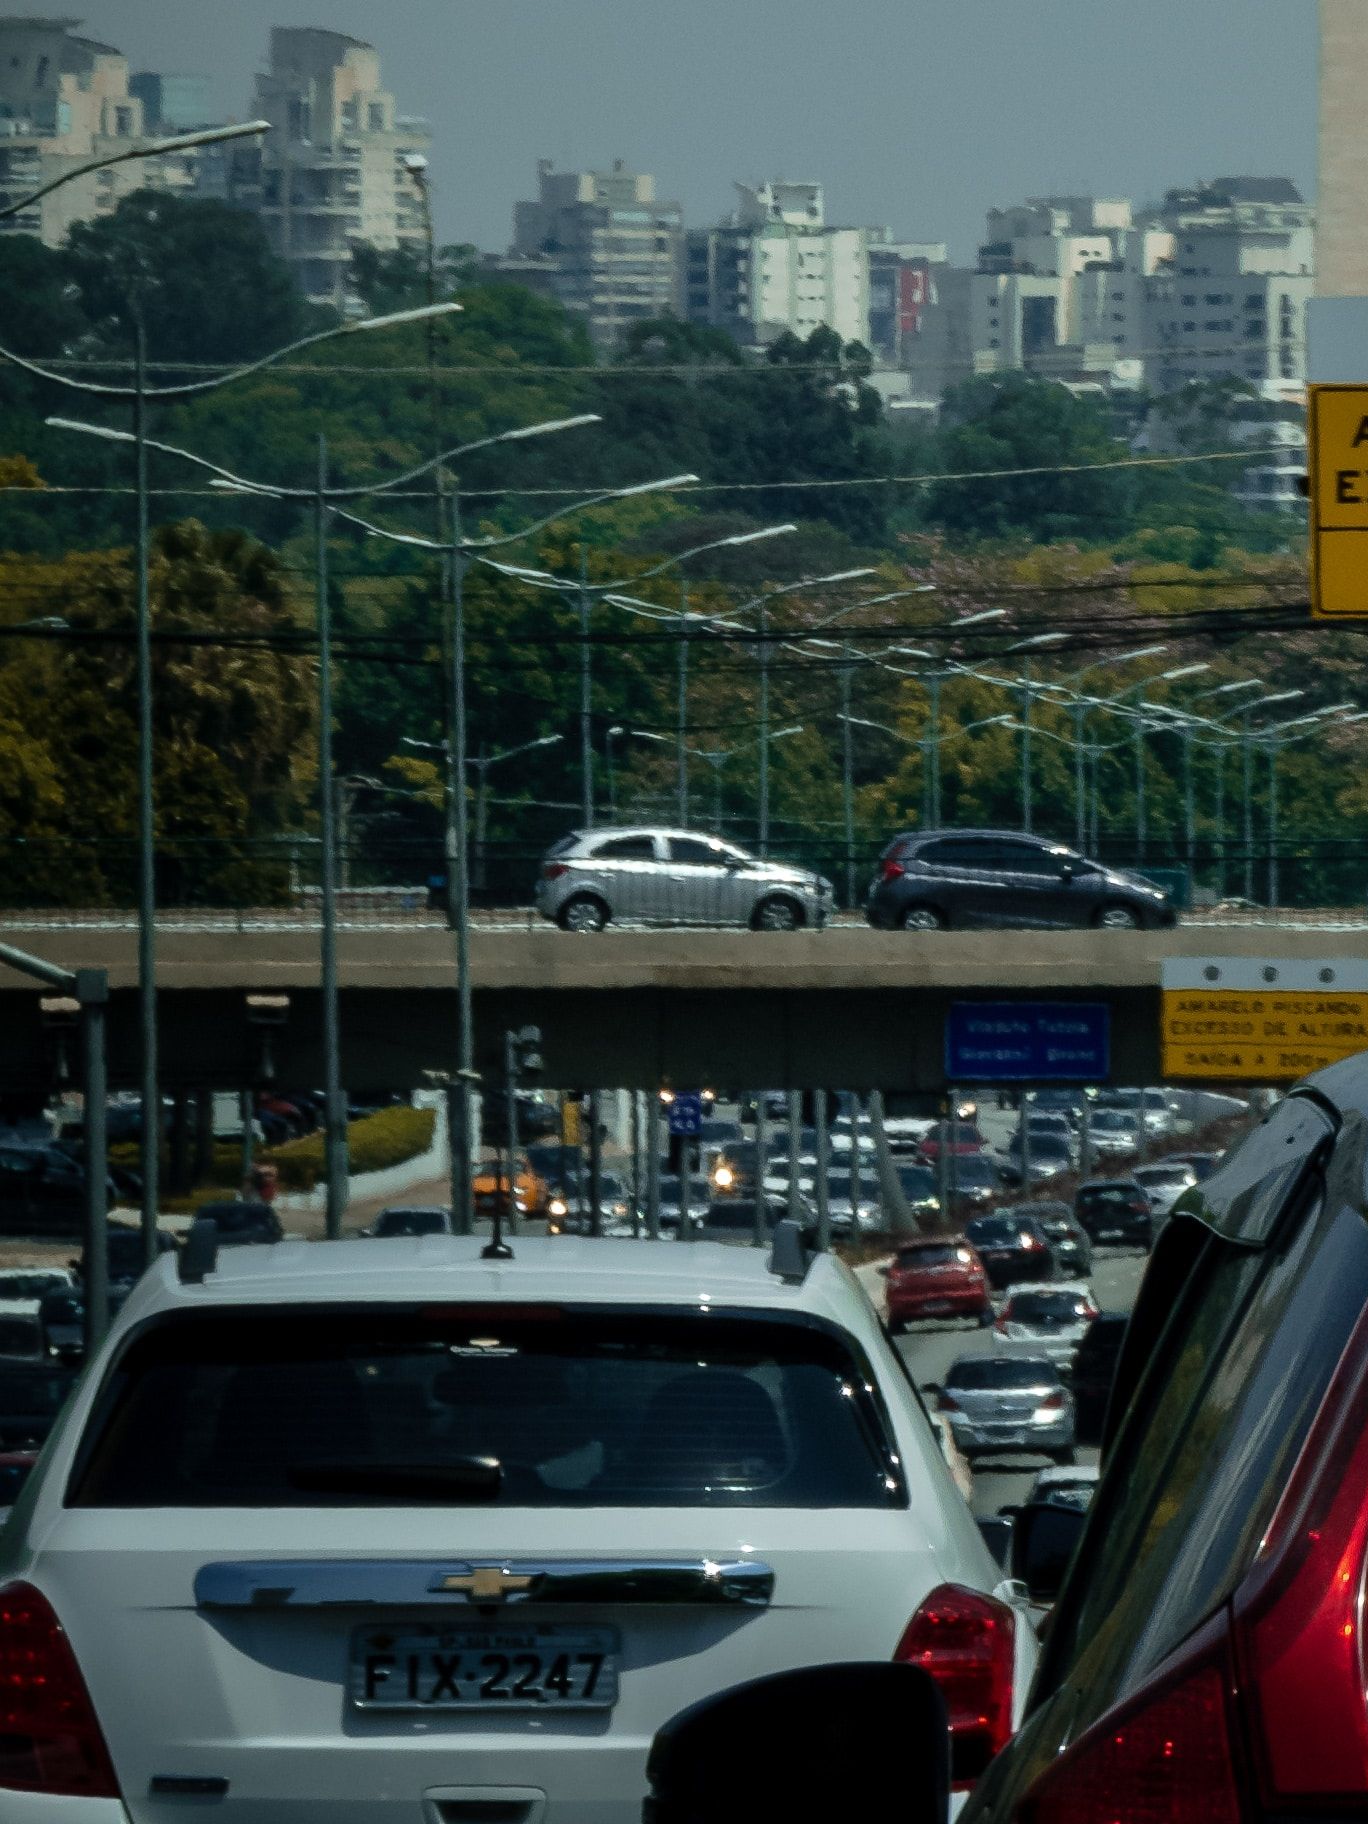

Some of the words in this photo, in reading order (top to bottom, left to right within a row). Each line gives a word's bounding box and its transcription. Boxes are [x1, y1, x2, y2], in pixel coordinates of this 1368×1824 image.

[1176, 999, 1265, 1015] AMARELO
[1262, 1020, 1287, 1036] DE
[1298, 1021, 1368, 1038] ALTURA
